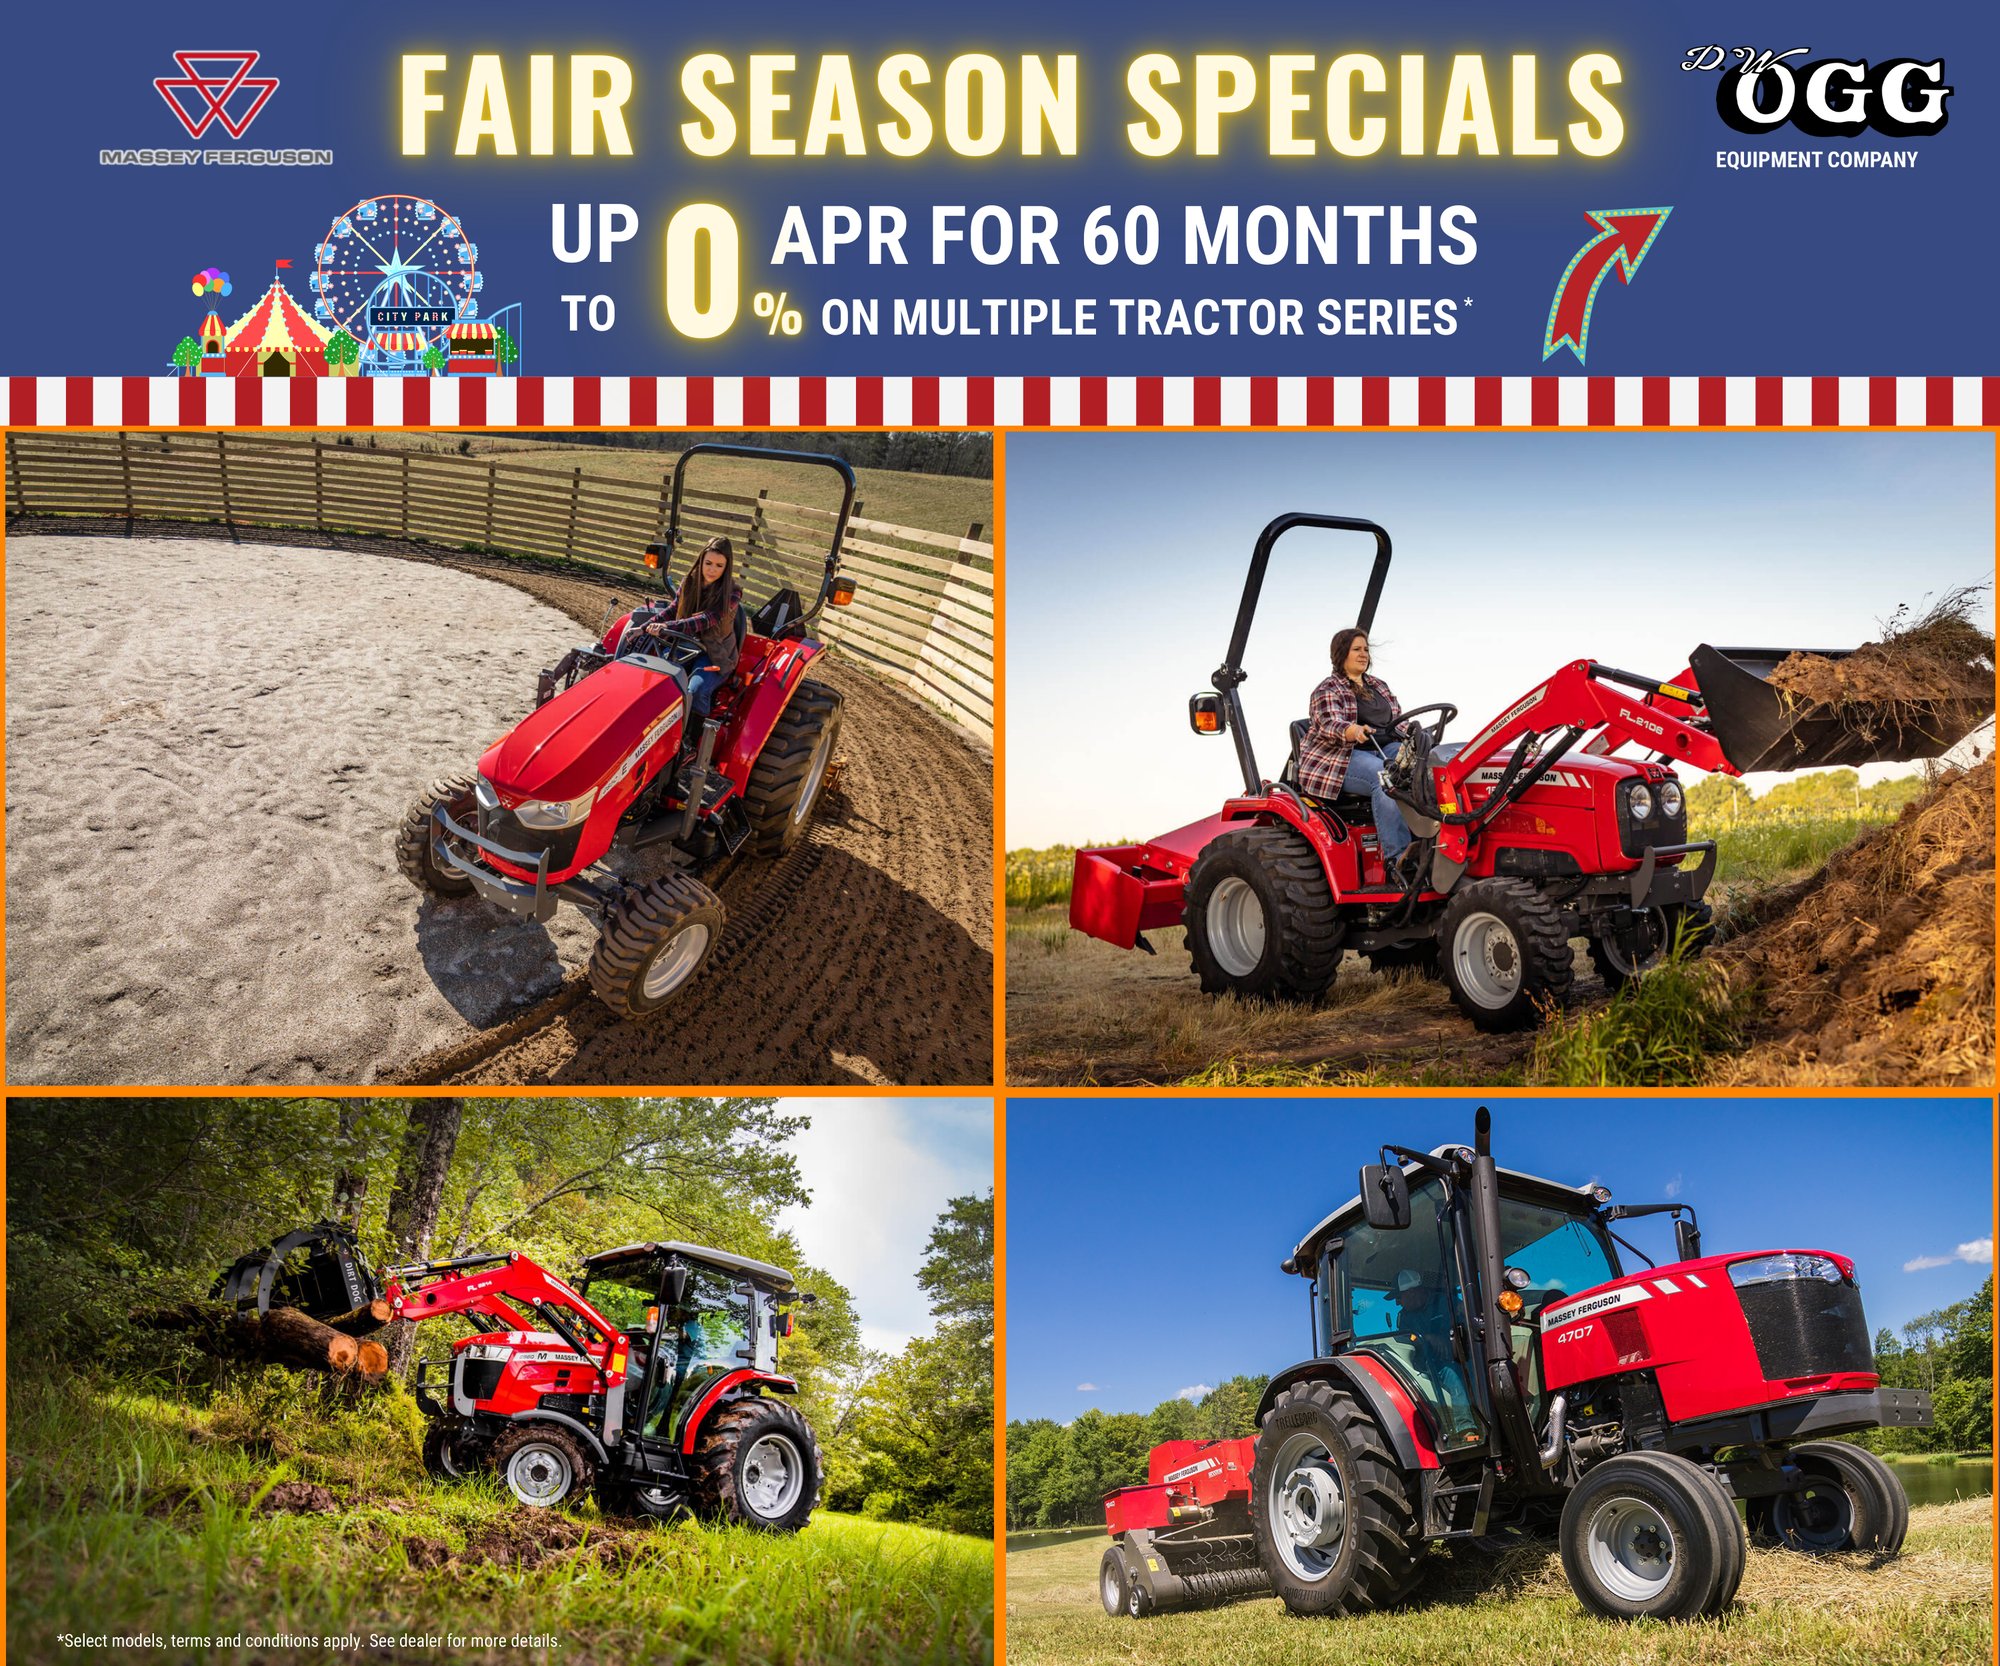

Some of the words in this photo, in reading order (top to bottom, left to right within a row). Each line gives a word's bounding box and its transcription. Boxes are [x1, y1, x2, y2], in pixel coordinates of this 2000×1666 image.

[377, 311, 408, 322] CITY
[414, 311, 448, 322] PARK
[1491, 714, 1511, 734] MASSEY
[1511, 695, 1538, 718] FERGUSON
[634, 734, 654, 759] MASSEY
[654, 711, 678, 740] FERGUSON
[344, 1262, 357, 1284] DIRT
[350, 1284, 362, 1303] DOG
[1547, 1308, 1577, 1327] MASSEY
[1577, 1293, 1621, 1315] FERGUSON
[1557, 1324, 1594, 1344] 4707
[537, 1352, 548, 1360] M
[1274, 1410, 1319, 1430] TRELLEBORG
[1167, 1473, 1181, 1483] MASSEY
[1181, 1465, 1199, 1477] FERGUSON
